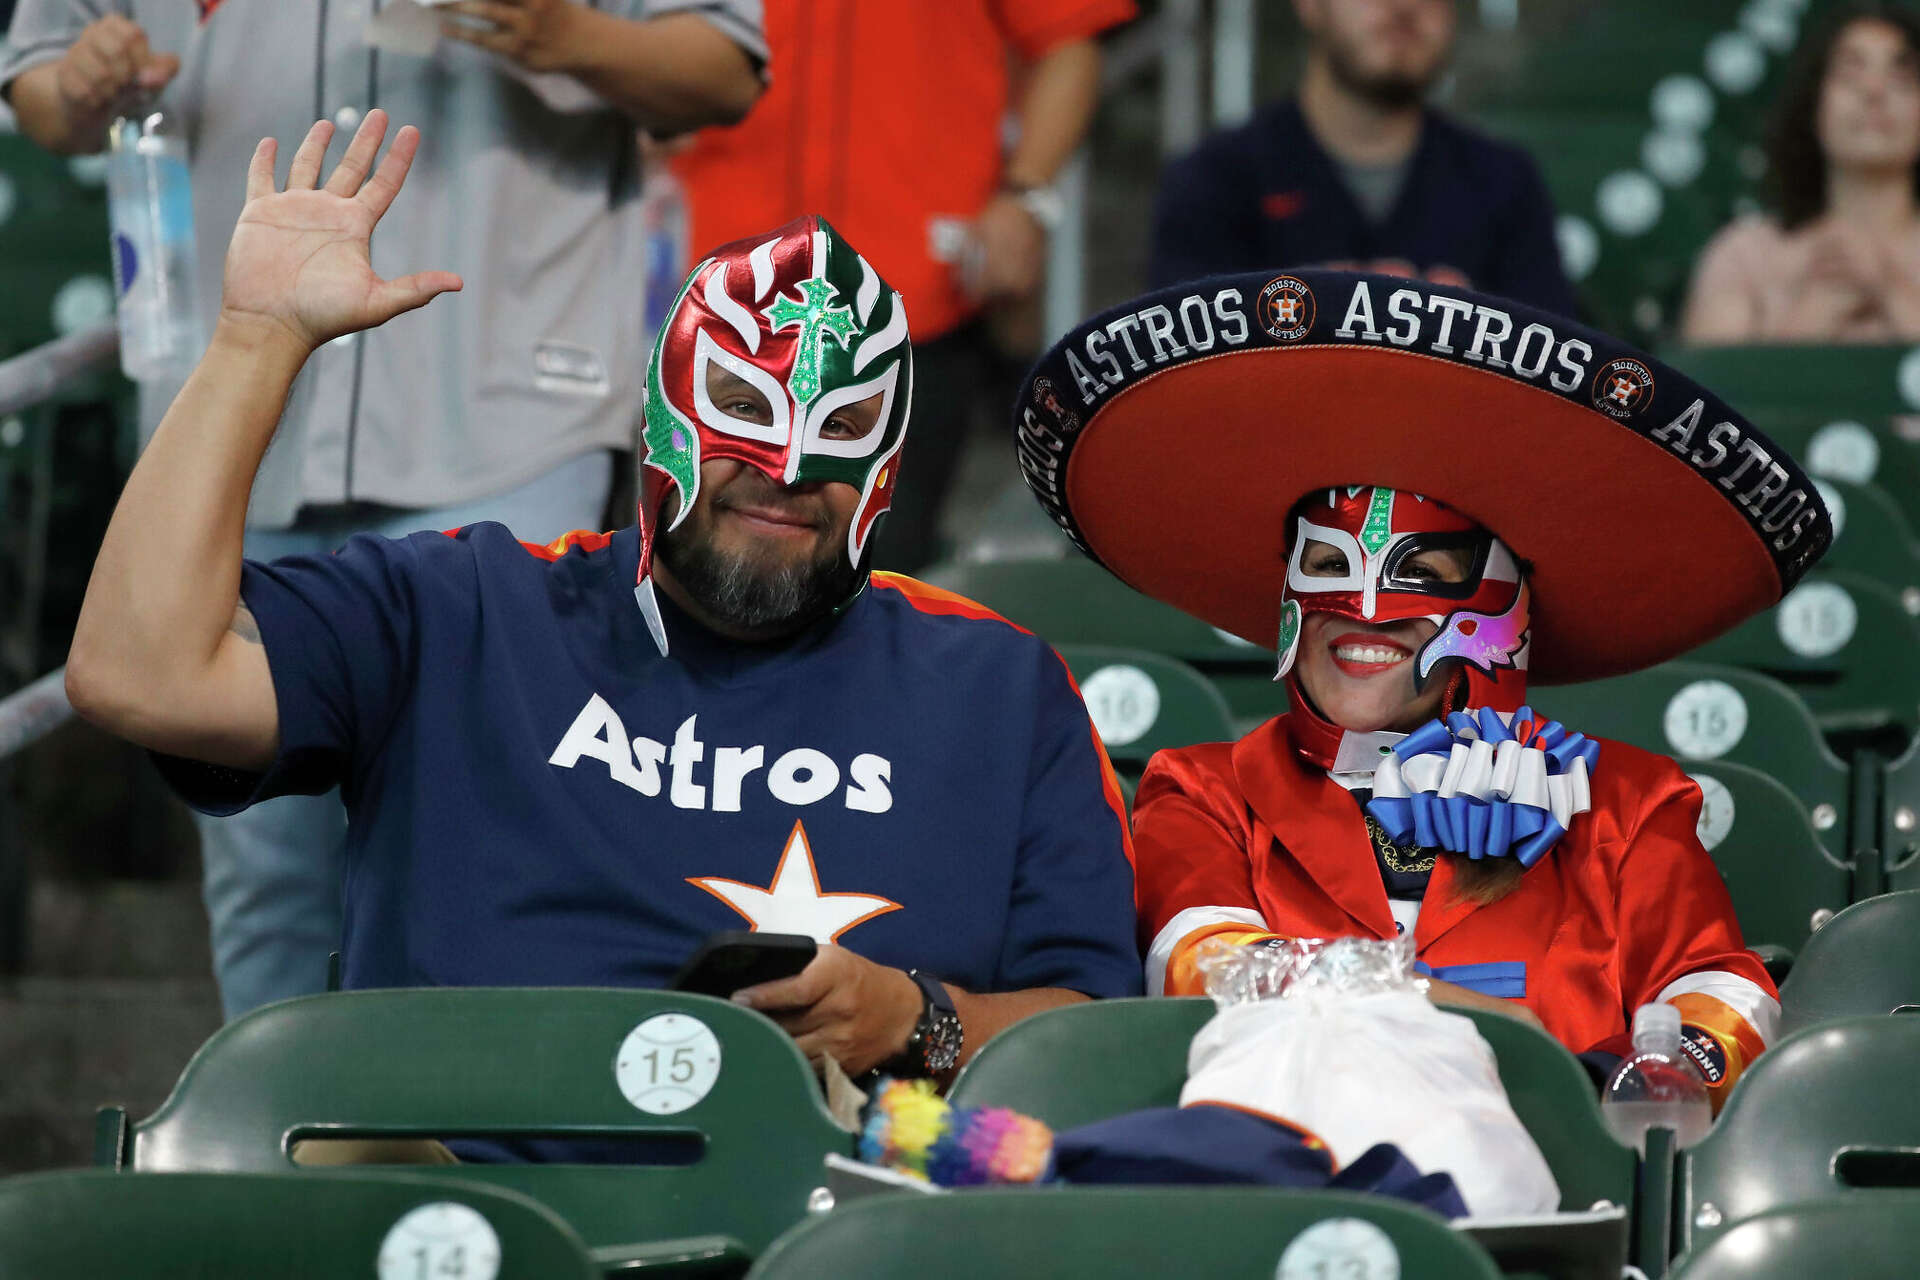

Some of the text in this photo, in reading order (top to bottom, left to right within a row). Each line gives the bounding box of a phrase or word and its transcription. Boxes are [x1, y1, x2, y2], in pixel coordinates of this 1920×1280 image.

[1263, 279, 1308, 297] HOUSTON
[1065, 288, 1250, 406] ASTROS
[1265, 325, 1307, 339] ASTROS
[1335, 280, 1593, 392] ASTROS
[1611, 361, 1653, 386] HOUSTON
[1651, 399, 1816, 551] ASTROS
[547, 692, 893, 813] Astros
[643, 1047, 695, 1084] 15
[411, 1245, 466, 1280] 14
